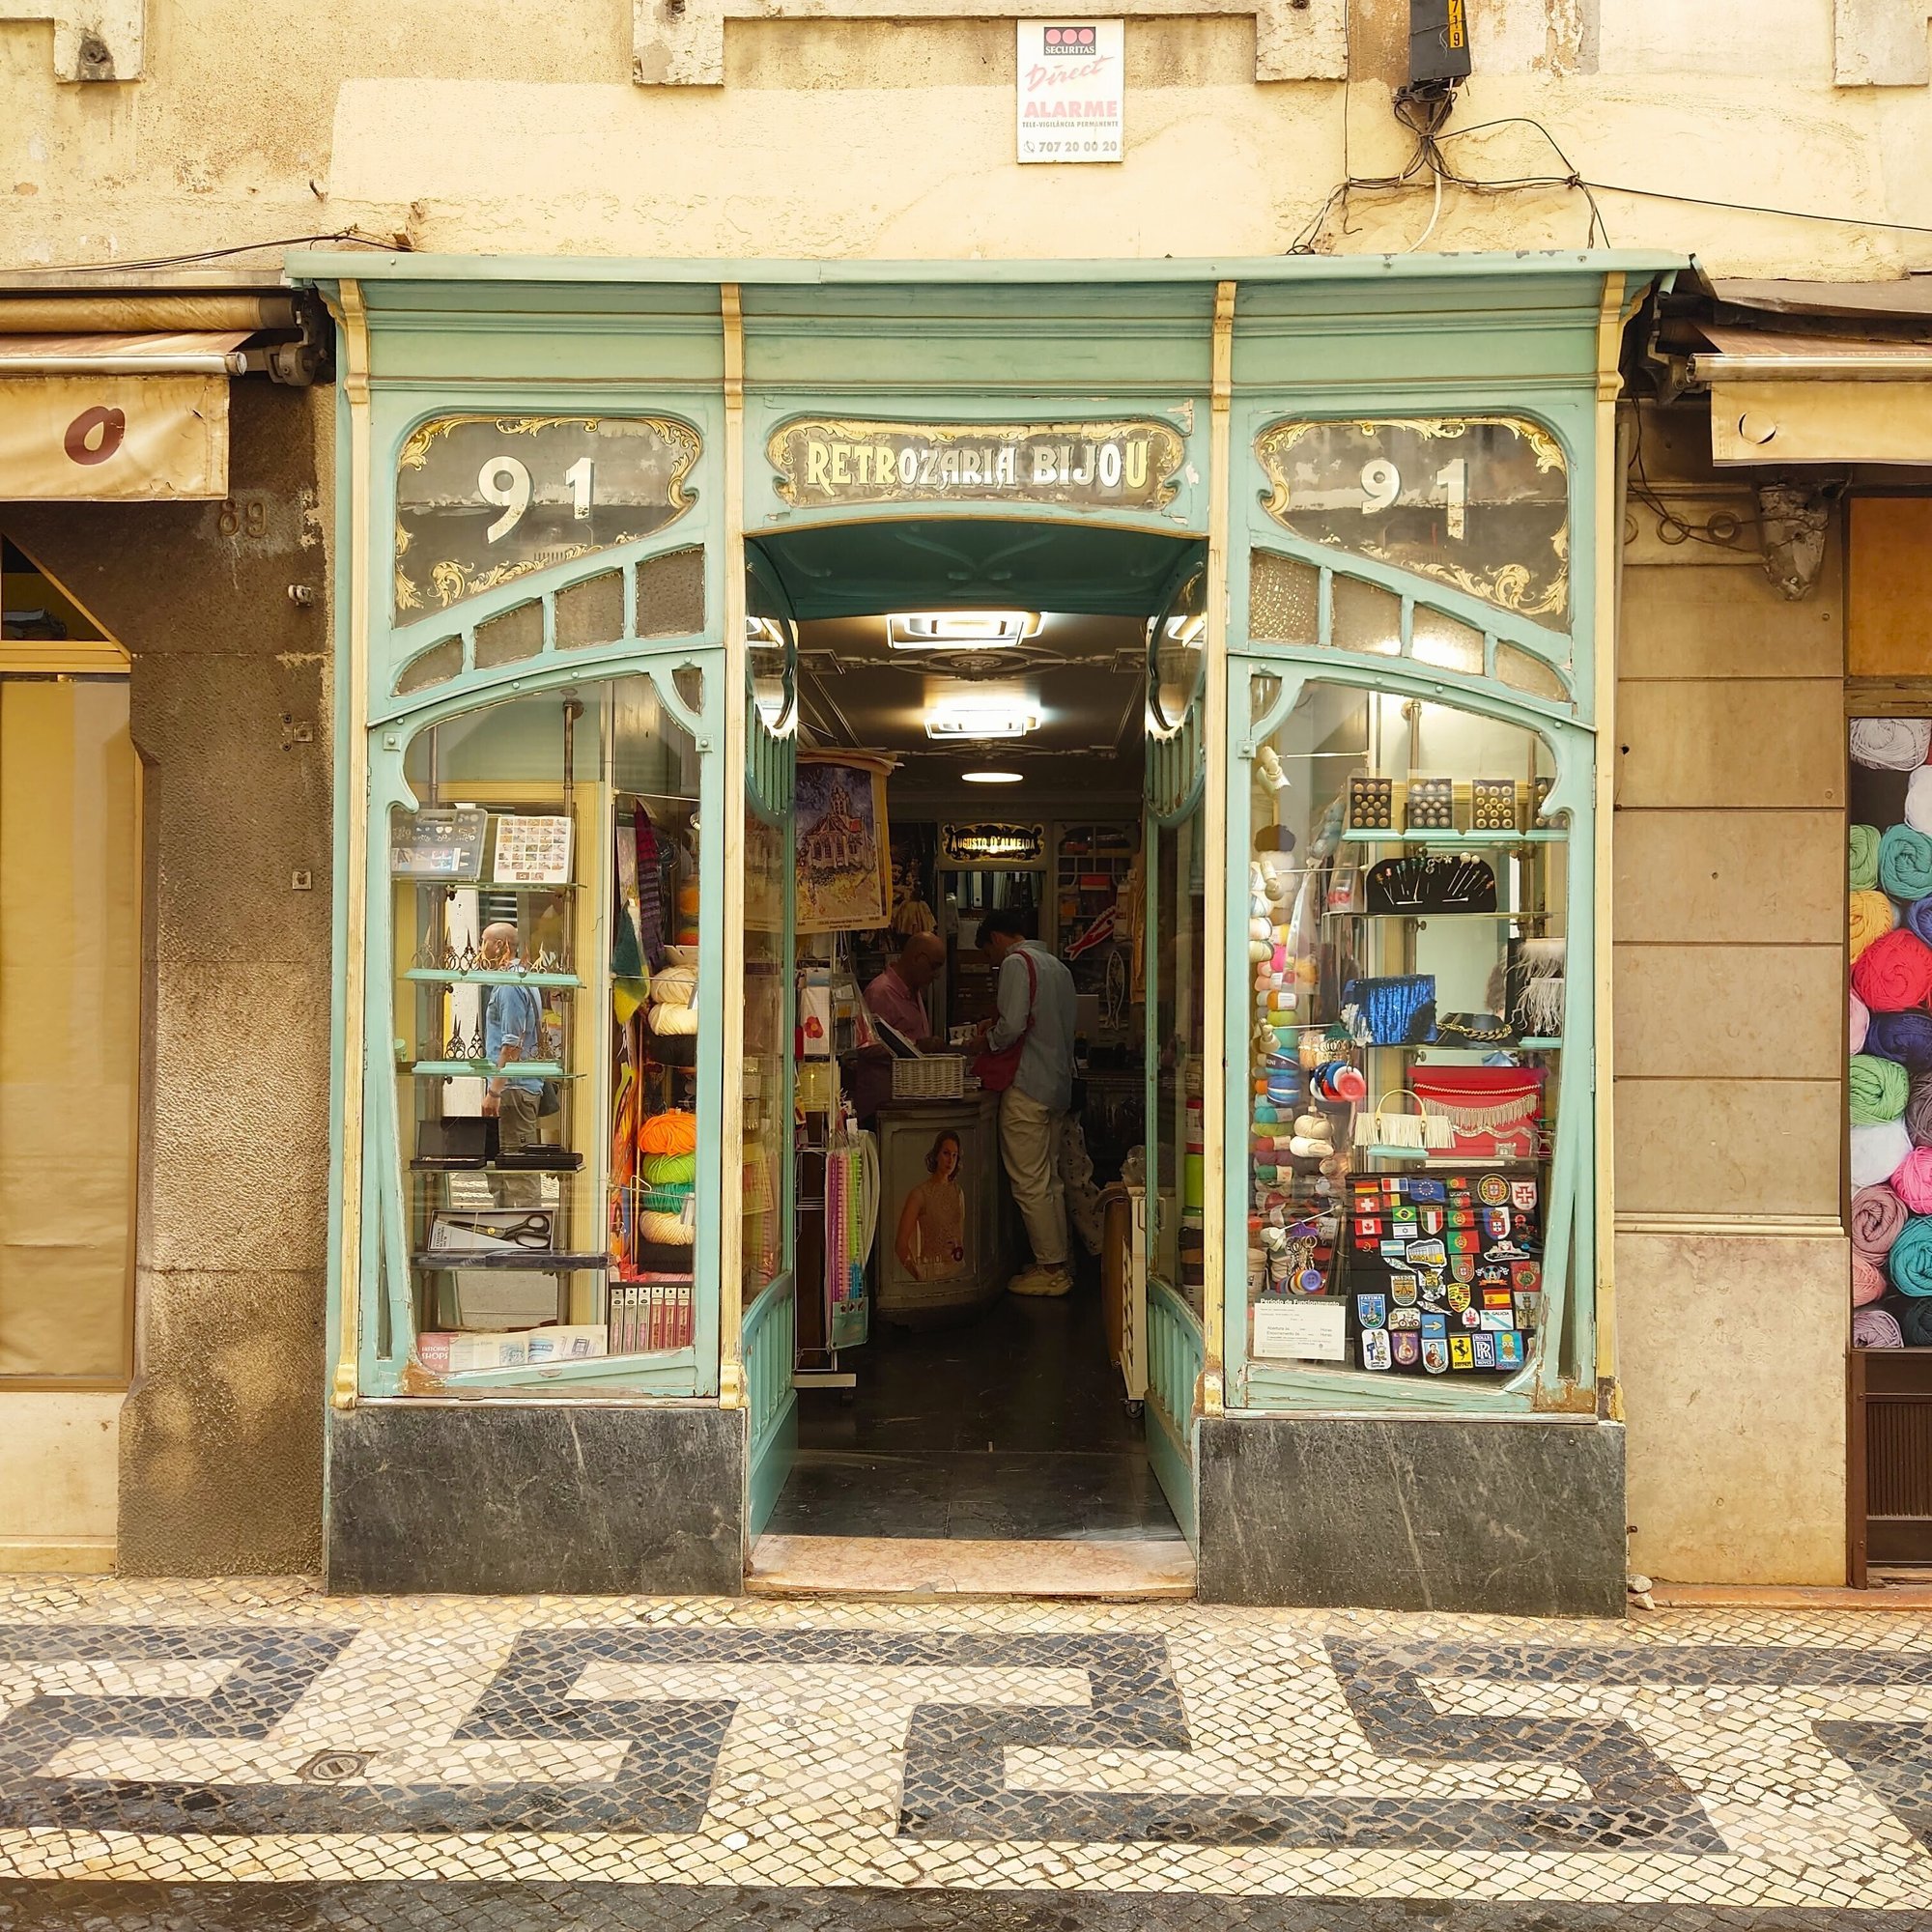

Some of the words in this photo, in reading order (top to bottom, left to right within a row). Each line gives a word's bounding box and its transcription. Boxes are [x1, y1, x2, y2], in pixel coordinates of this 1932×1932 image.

[1045, 45, 1095, 54] SECURITAS
[1024, 55, 1115, 92] Direct
[1024, 100, 1118, 118] ALARME
[1038, 141, 1062, 153] 707
[1065, 141, 1080, 152] 20
[1084, 141, 1098, 152] 00
[1102, 141, 1118, 152] 20
[807, 440, 1017, 497] RETROZARIA
[1031, 440, 1151, 489] BIJOU
[477, 456, 595, 544] 91
[1360, 457, 1468, 541] 91
[219, 499, 268, 538] 89
[951, 835, 987, 851] AUGUSTO
[421, 1351, 449, 1360] SHOPS
